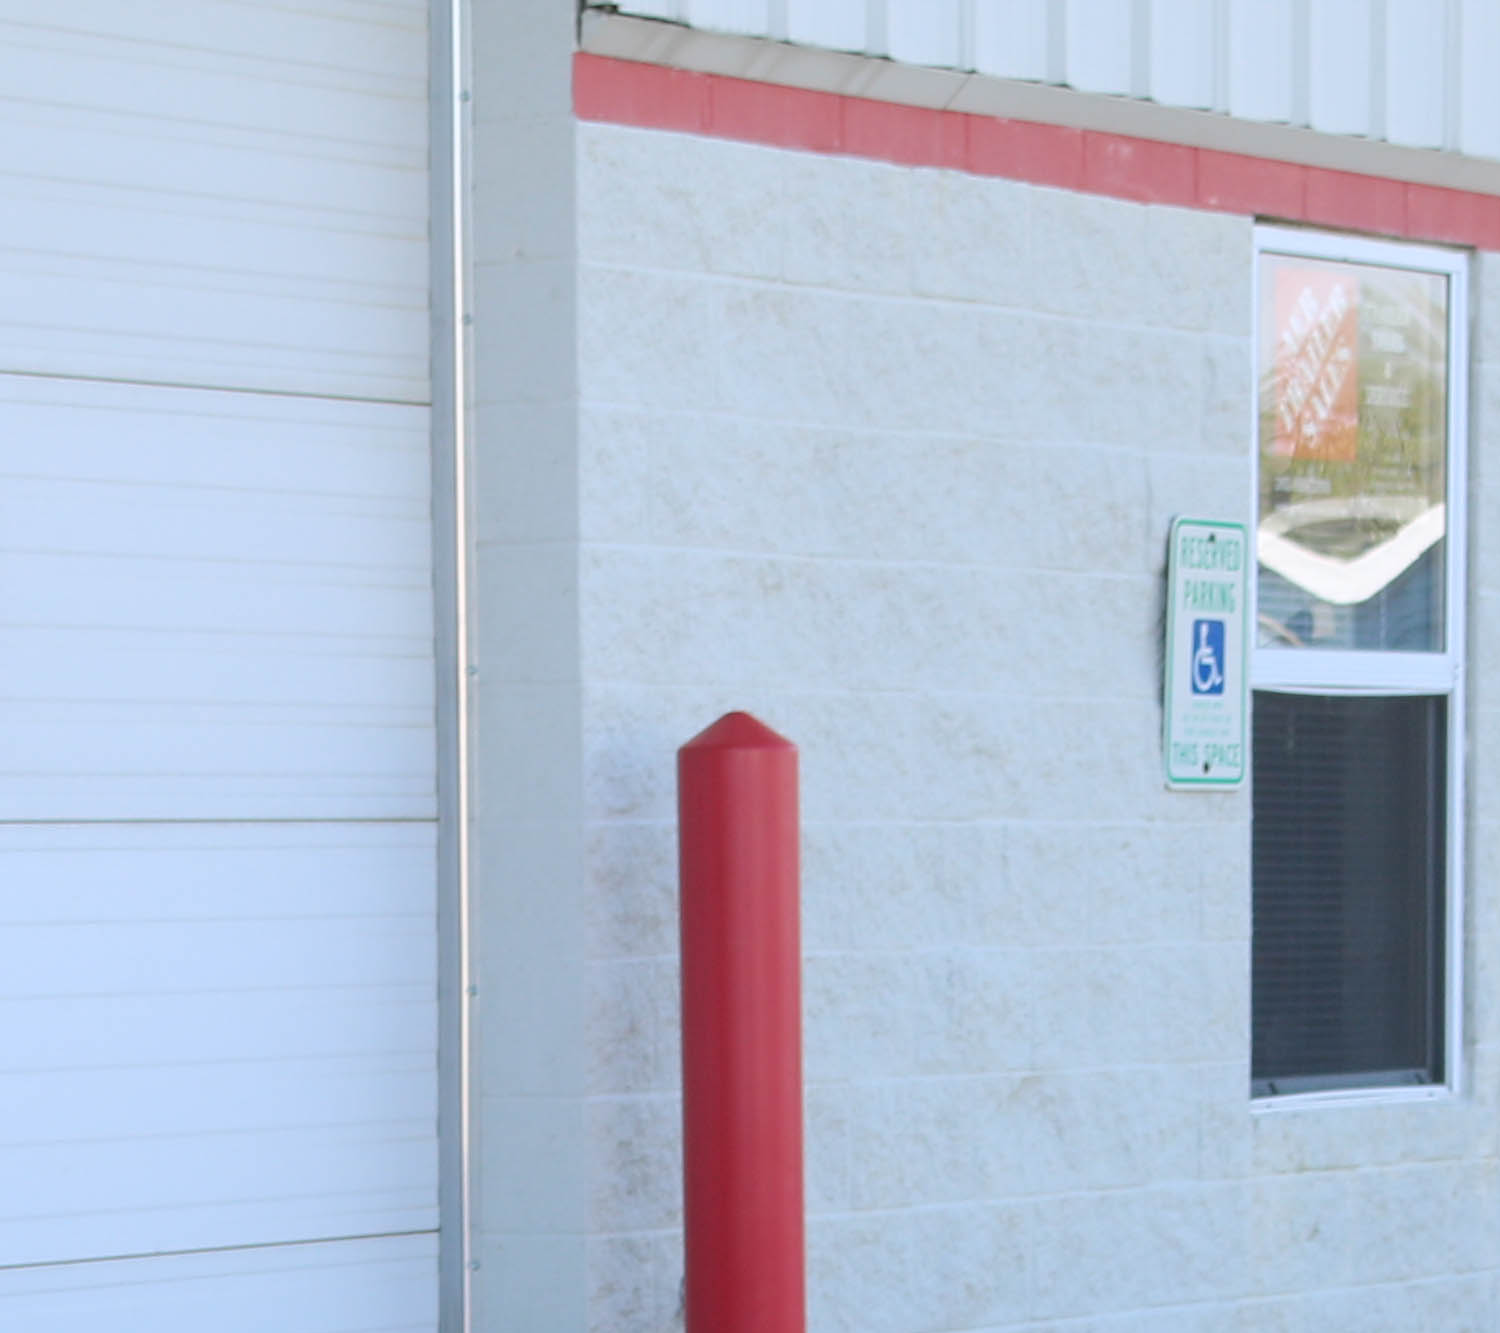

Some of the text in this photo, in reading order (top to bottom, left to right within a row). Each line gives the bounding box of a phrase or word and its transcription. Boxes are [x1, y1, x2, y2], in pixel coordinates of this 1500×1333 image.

[1180, 536, 1241, 571] RESERVED
[1183, 579, 1235, 613] PARKING
[1172, 743, 1240, 768] THIS SPACE
